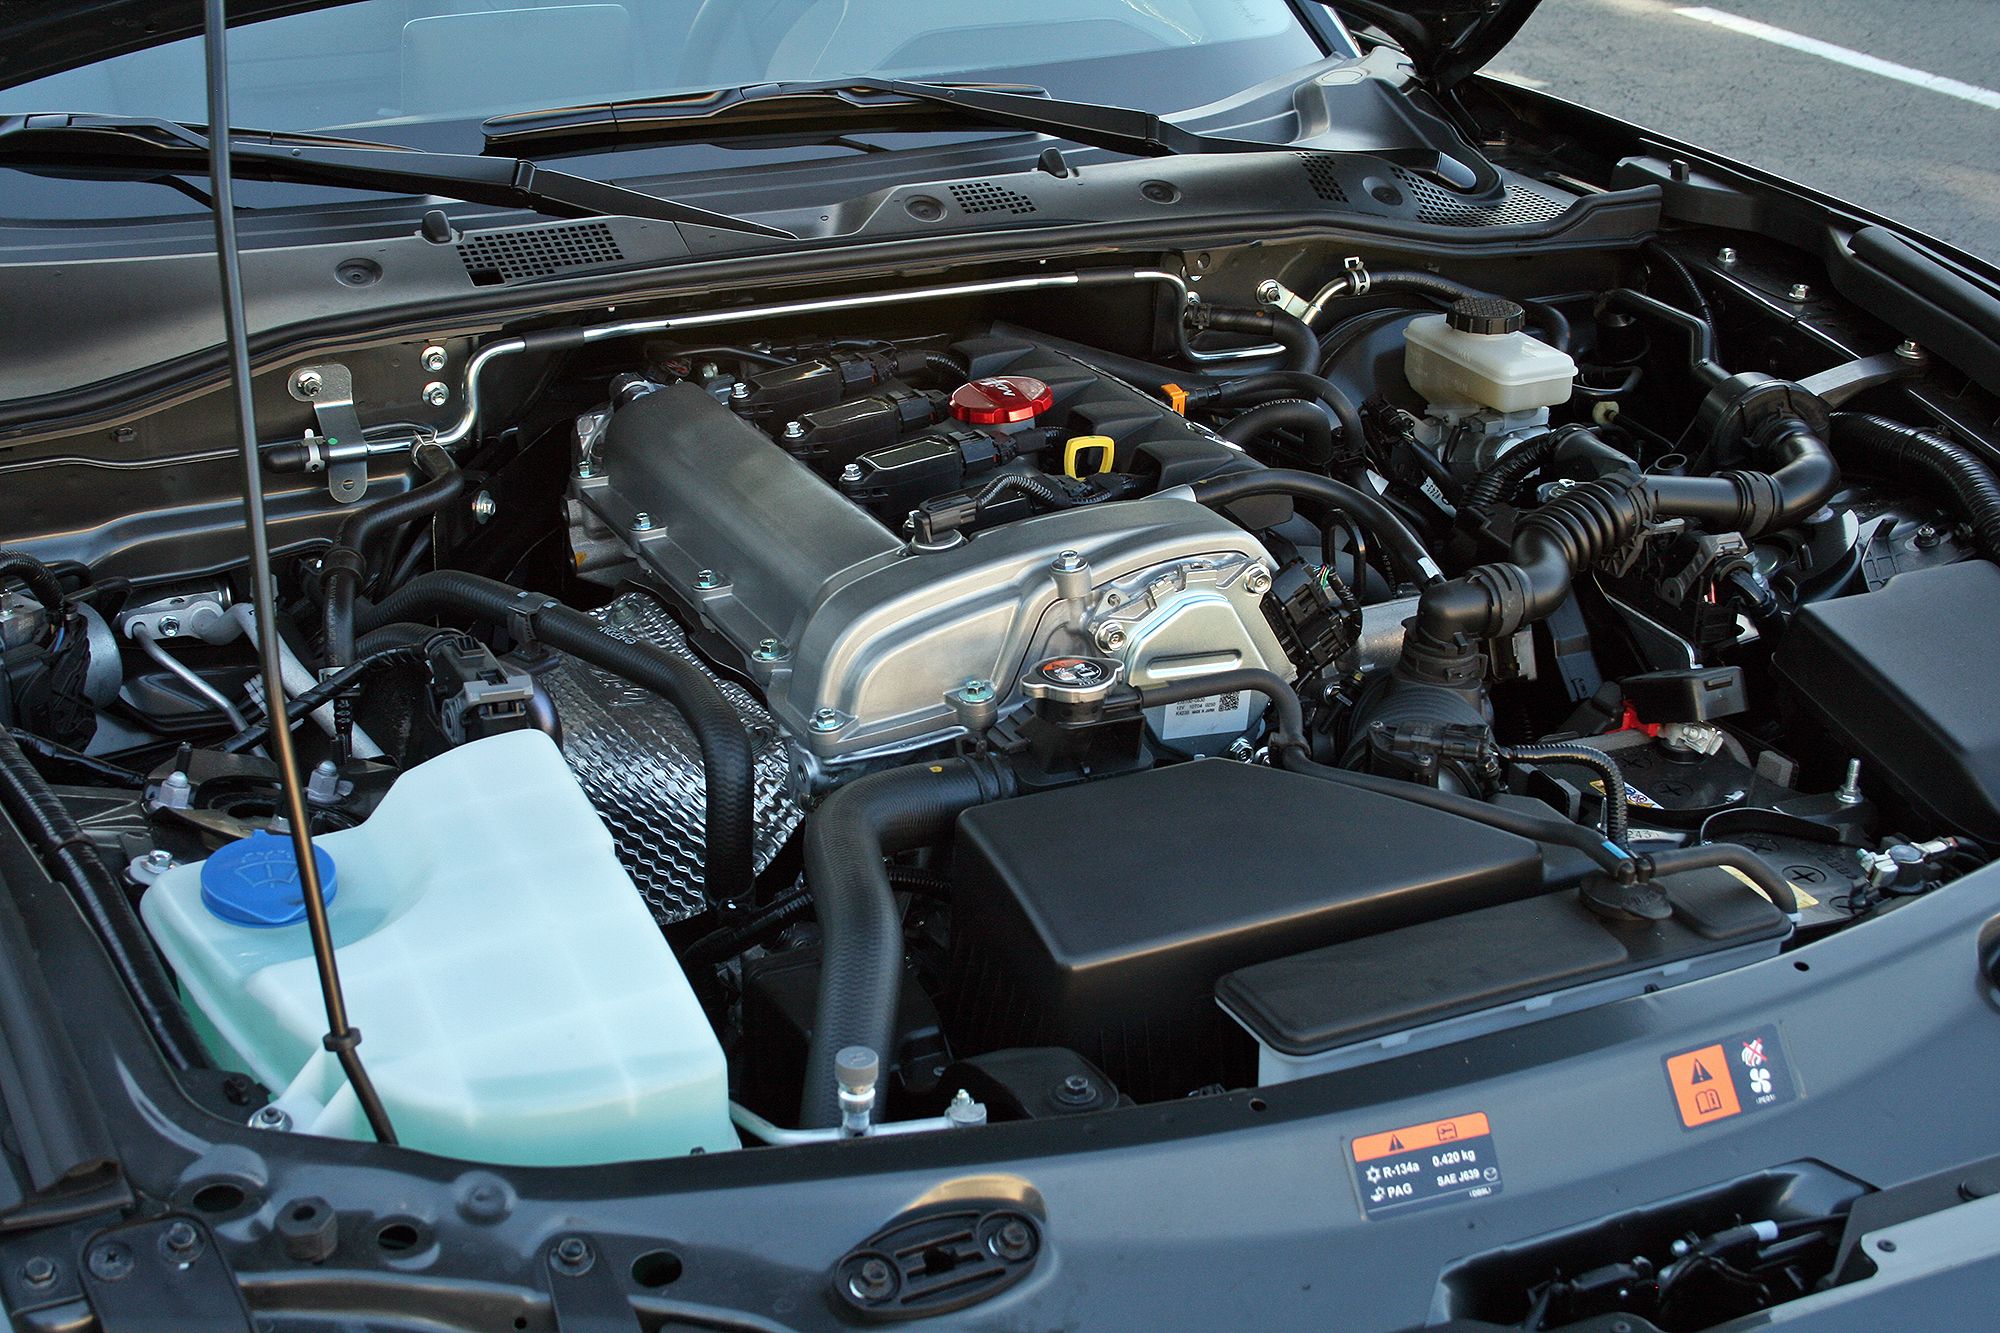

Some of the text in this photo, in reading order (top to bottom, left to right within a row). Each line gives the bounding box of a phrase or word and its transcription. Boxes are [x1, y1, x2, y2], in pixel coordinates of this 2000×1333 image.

[1432, 1149, 1476, 1168] 0.420 kg
[1382, 1161, 1420, 1179] R-134a
[1436, 1168, 1480, 1187] SAE J639
[1387, 1182, 1413, 1198] PAG
